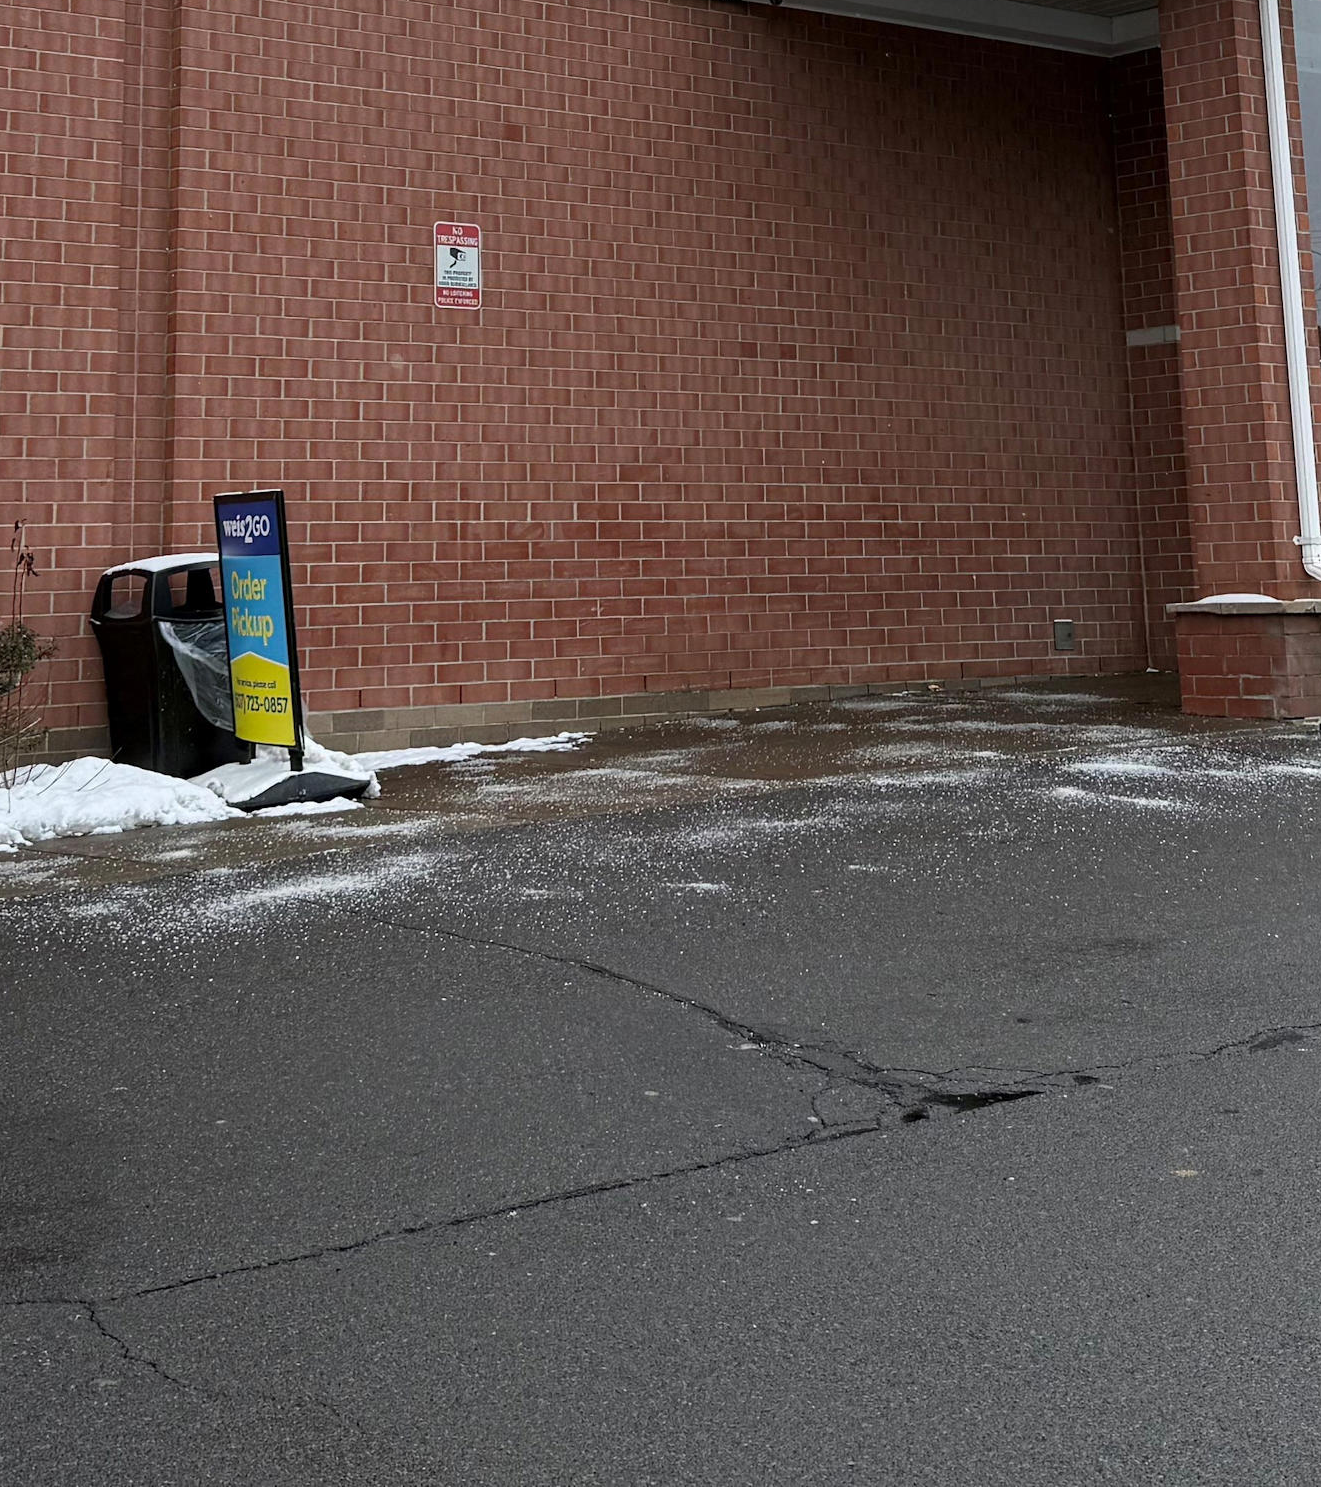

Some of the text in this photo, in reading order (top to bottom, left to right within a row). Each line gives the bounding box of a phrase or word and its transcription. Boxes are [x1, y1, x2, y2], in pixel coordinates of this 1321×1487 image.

[437, 234, 478, 246] TRESPASSING
[452, 226, 463, 235] NO
[232, 570, 267, 600] Order
[232, 607, 274, 646] Pickup
